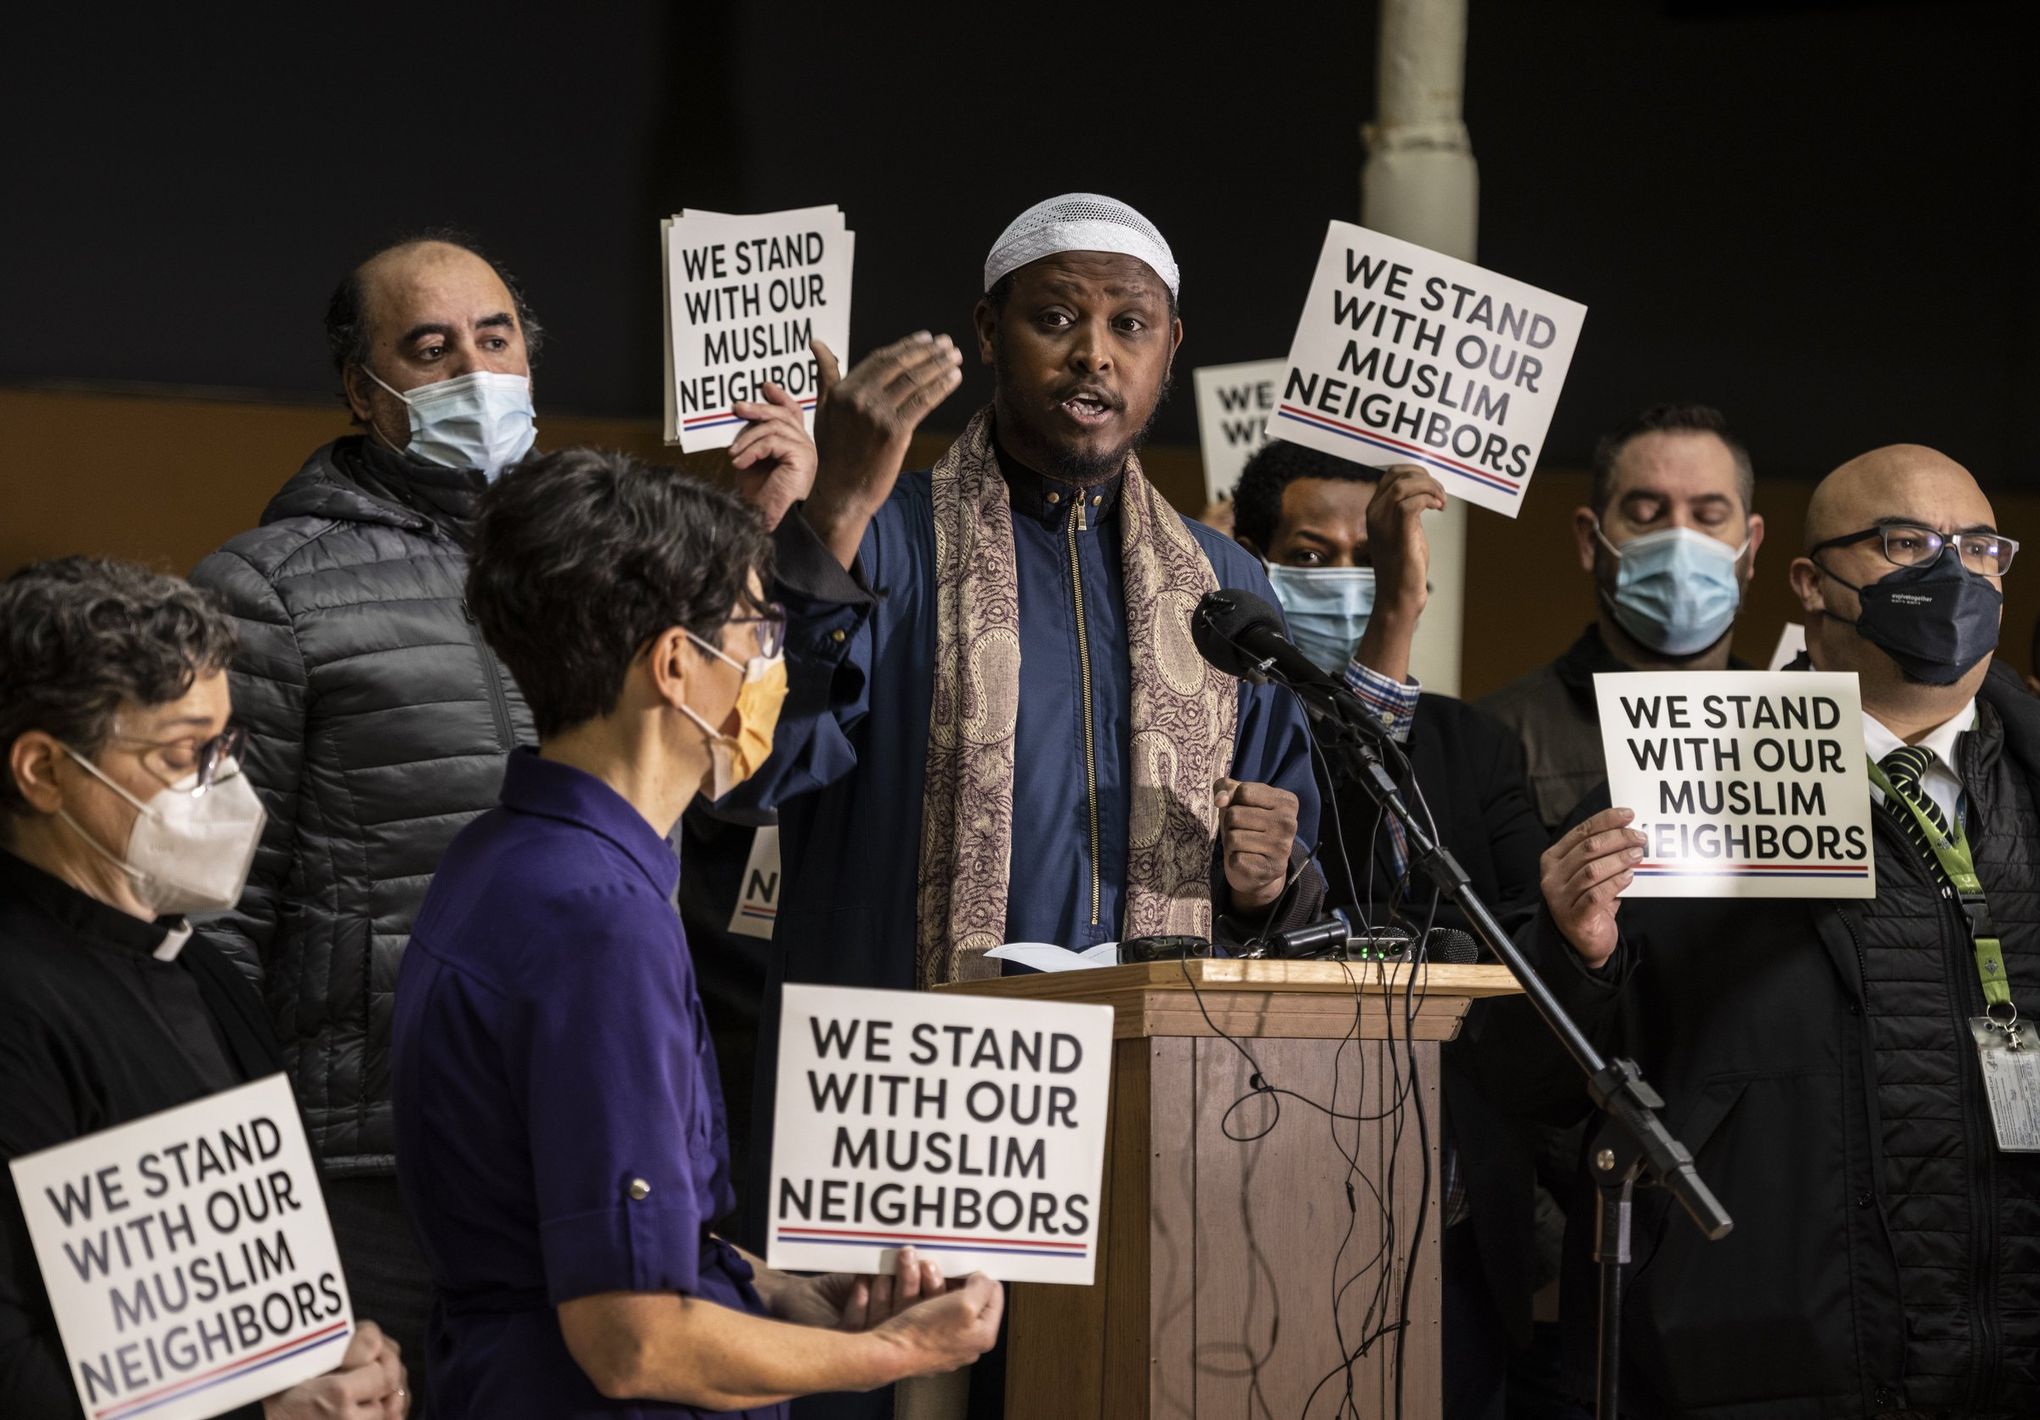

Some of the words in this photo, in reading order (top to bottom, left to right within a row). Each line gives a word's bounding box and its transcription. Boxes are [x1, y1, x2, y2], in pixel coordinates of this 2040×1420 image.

[682, 244, 727, 282] WE
[735, 231, 825, 275] STAND
[685, 282, 760, 326] WITH
[769, 273, 827, 313] OUR
[1346, 248, 1413, 300] WE
[1420, 277, 1556, 350] STAND
[704, 317, 813, 367] MUSLIM
[1334, 290, 1446, 357] WITH
[1455, 335, 1543, 394] OUR
[680, 359, 819, 414] NEIGHBOR
[1216, 381, 1274, 412] WE
[1337, 339, 1511, 426] MUSLIM
[1283, 367, 1532, 478] NEIGHBORS
[1619, 695, 1691, 729] WE
[1703, 694, 1841, 730] STAND
[1626, 737, 1741, 772] WITH
[1753, 737, 1846, 774] OUR
[1659, 780, 1827, 816] MUSLIM
[809, 1016, 893, 1062] WE
[909, 1023, 1083, 1074] STAND
[807, 1070, 948, 1120] WITH
[966, 1080, 1079, 1129] OUR
[45, 1165, 130, 1228] WE
[138, 1117, 281, 1198] STAND
[831, 1126, 1046, 1180] MUSLIM
[63, 1203, 197, 1284] WITH
[206, 1170, 302, 1234] OUR
[777, 1177, 1090, 1236] NEIGHBORS
[109, 1230, 296, 1333] MUSLIM
[79, 1272, 344, 1404] NEIGHBORS
